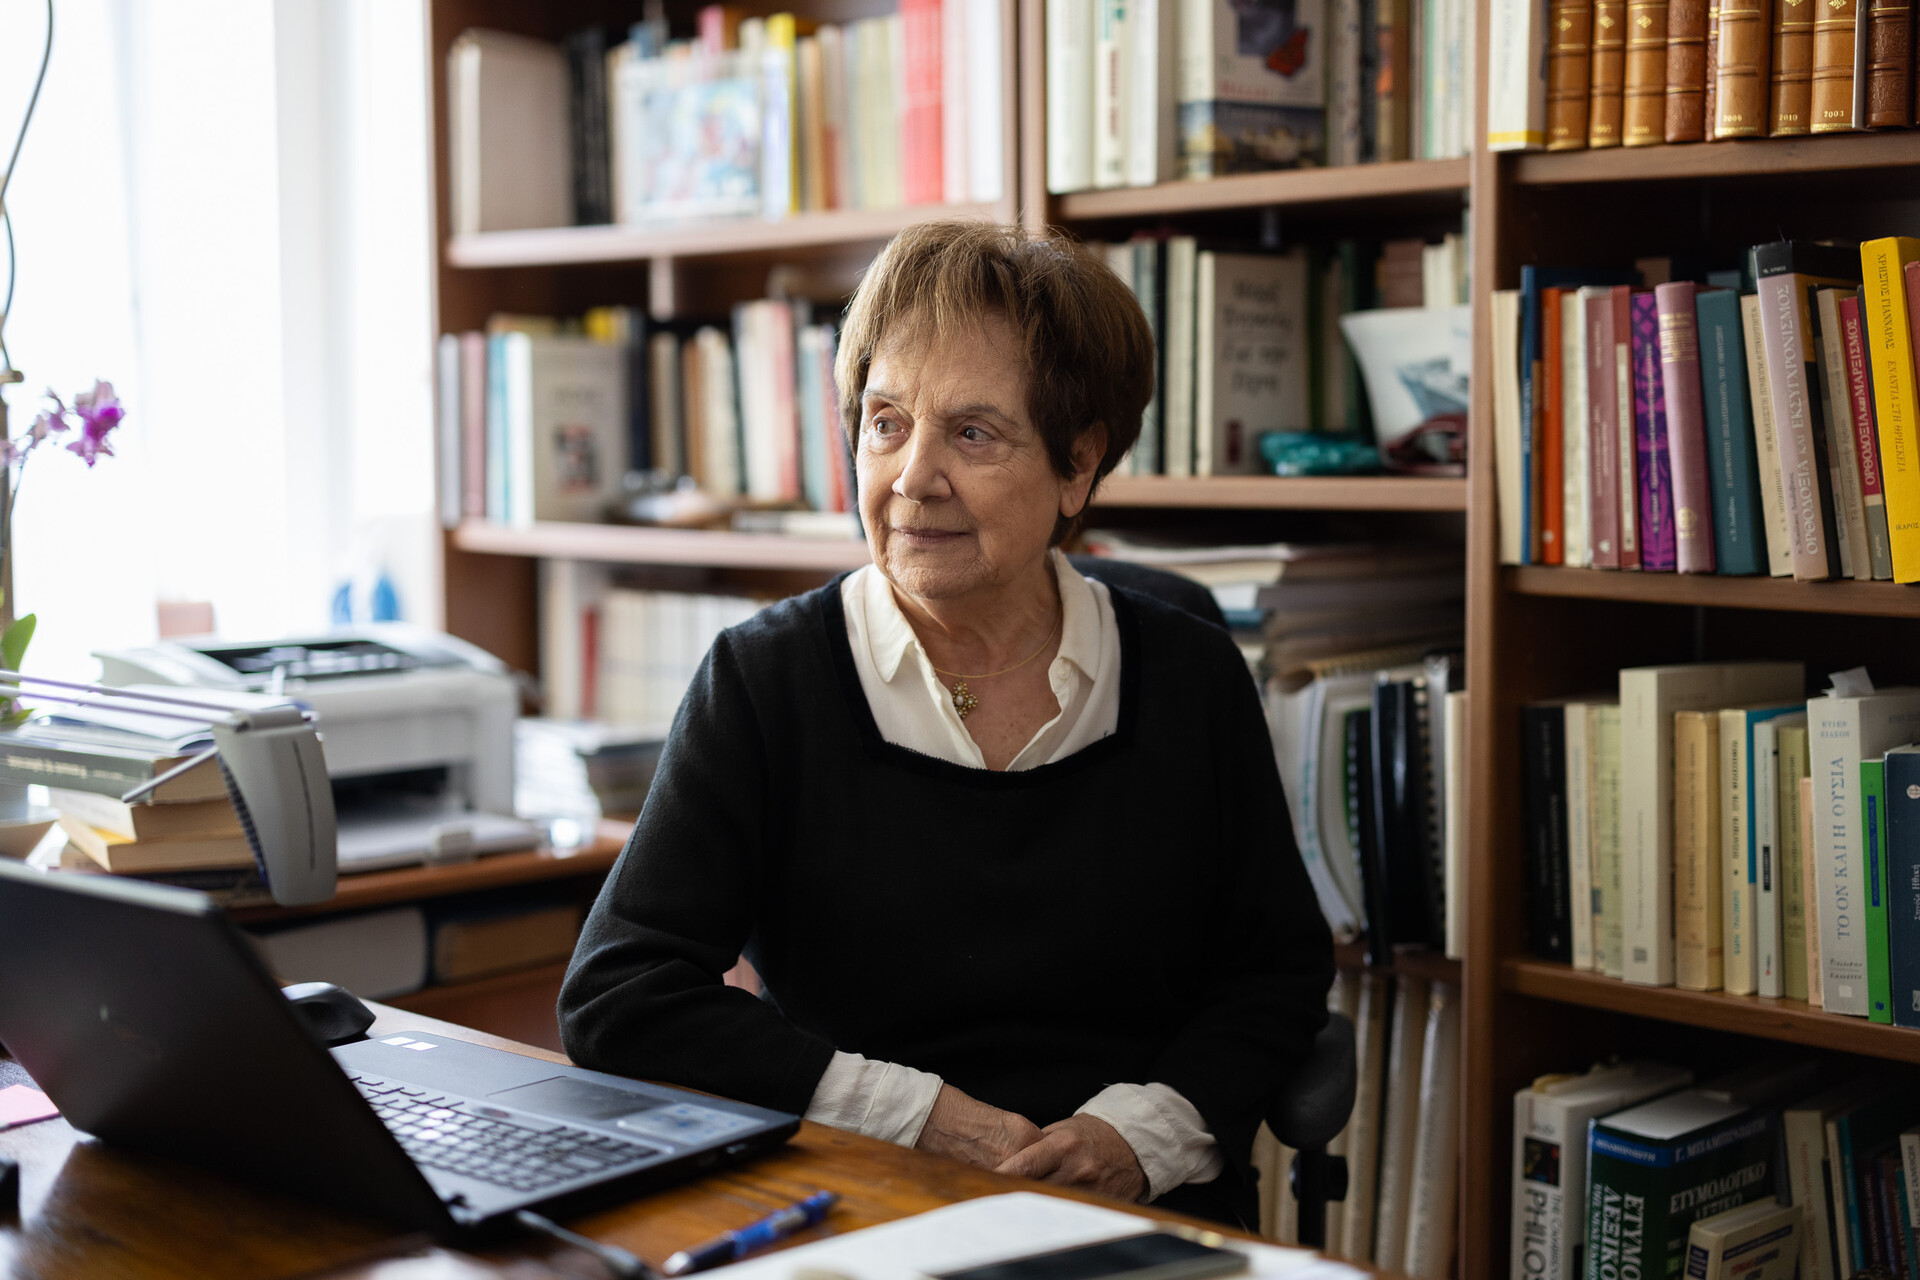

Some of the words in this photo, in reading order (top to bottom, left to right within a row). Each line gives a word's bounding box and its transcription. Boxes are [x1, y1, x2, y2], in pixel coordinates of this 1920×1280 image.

[1823, 110, 1844, 118] 2003
[1878, 253, 1890, 296] ΧΡΗΣΤΟΣ
[1881, 299, 1895, 349] ΓΙΑΝΝΑΡΑΣ
[1776, 284, 1804, 429] ΕΚΣΥΓΧΡΟΝΙΣΜΟΣ
[1847, 318, 1865, 396] ΜΑΡΞΙΣΜΟΣ
[1888, 360, 1900, 400] ΕΝΑΝΤΙΑ
[1892, 403, 1902, 422] ΣΤΗ
[1858, 413, 1876, 486] ΟΡΘΟΔΟΞΙΑ
[1894, 425, 1906, 473] ΘΡΗΣΚΕΙΑ
[1797, 459, 1818, 555] ΟΡΘΟΔΟΞΙΑ
[1895, 522, 1919, 531] ΙΚΑΡΟΣ
[1831, 757, 1846, 817] ΟΥΣΙΑ
[1833, 825, 1846, 837] Η
[1833, 843, 1848, 878] ΚΑΙ
[1911, 864, 1920, 890] Ηθική
[1836, 885, 1850, 916] ΟΝ
[1837, 920, 1851, 940] ΤΟ
[1669, 1161, 1768, 1215] ΕΤΥΜΟΛΟΓΙΚΟ
[1599, 1185, 1623, 1280] ΛΕΞΙΚΟ
